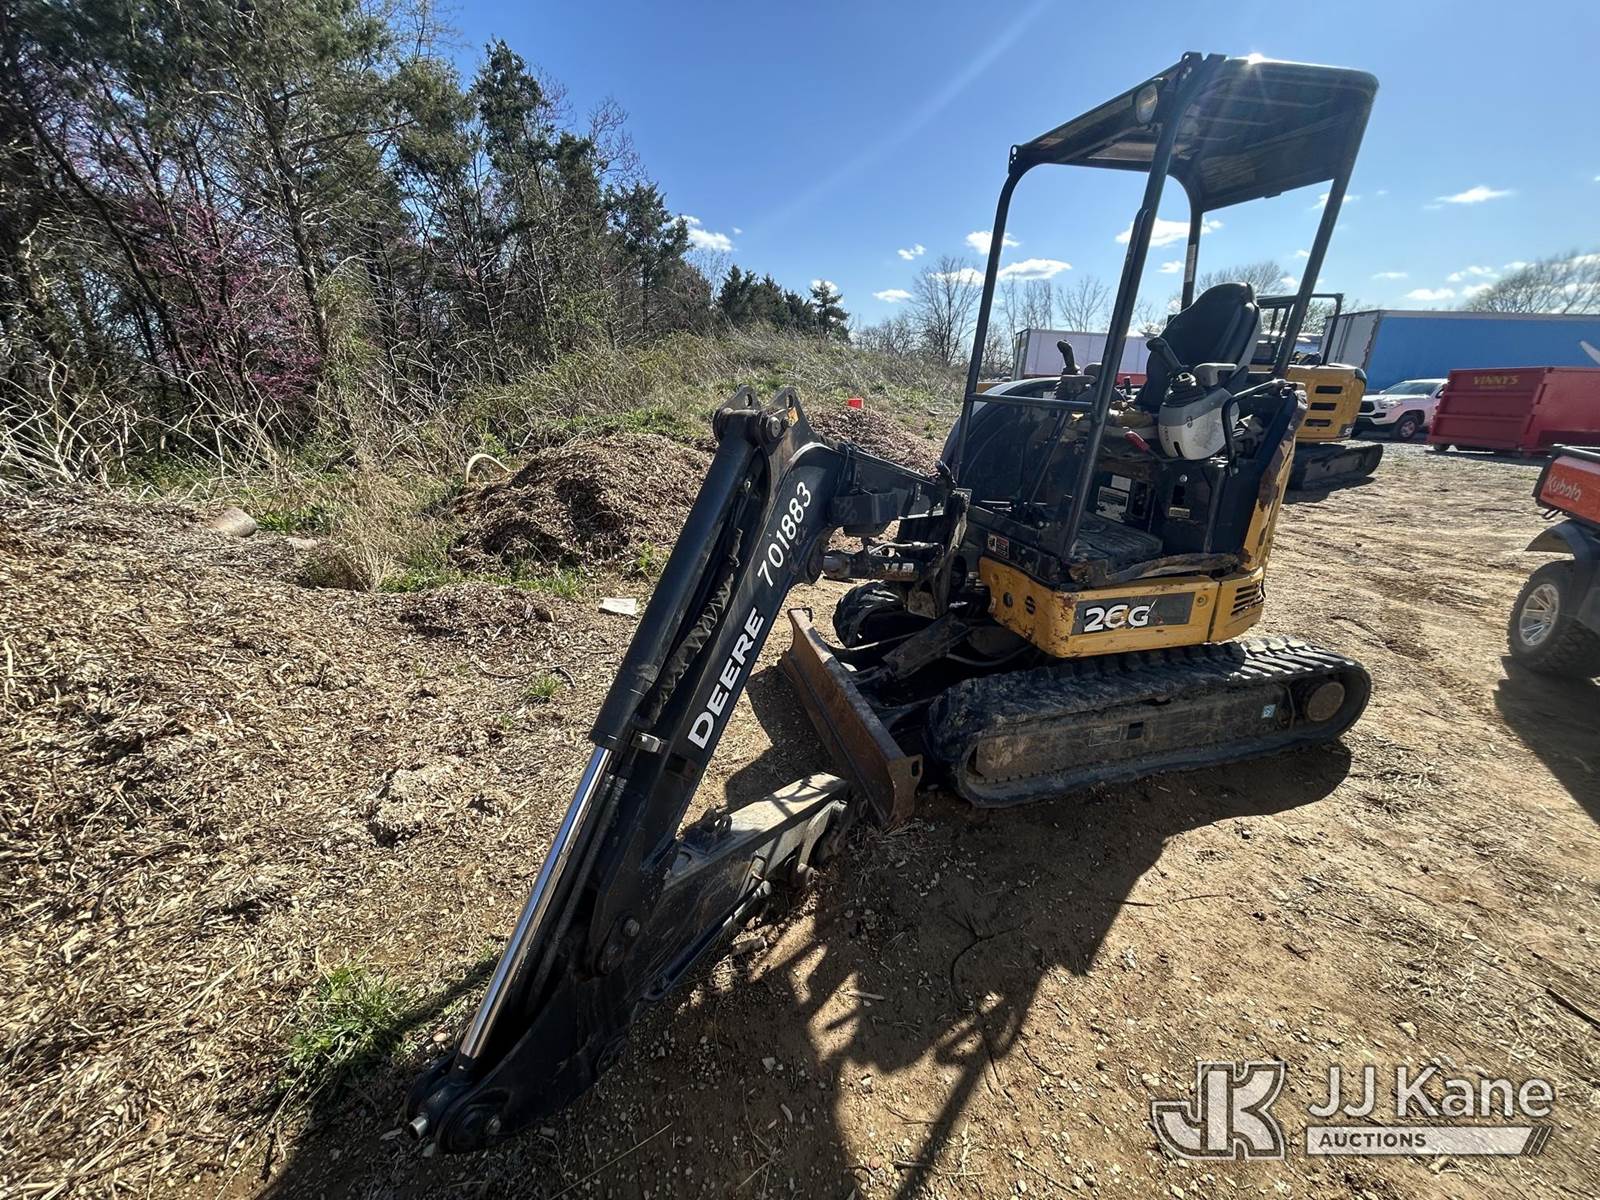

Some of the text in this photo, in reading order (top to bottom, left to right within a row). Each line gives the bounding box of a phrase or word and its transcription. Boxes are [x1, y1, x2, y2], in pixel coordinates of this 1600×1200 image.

[757, 481, 811, 587] 701883
[1547, 475, 1581, 502] Kubota
[688, 607, 764, 749] DEERE
